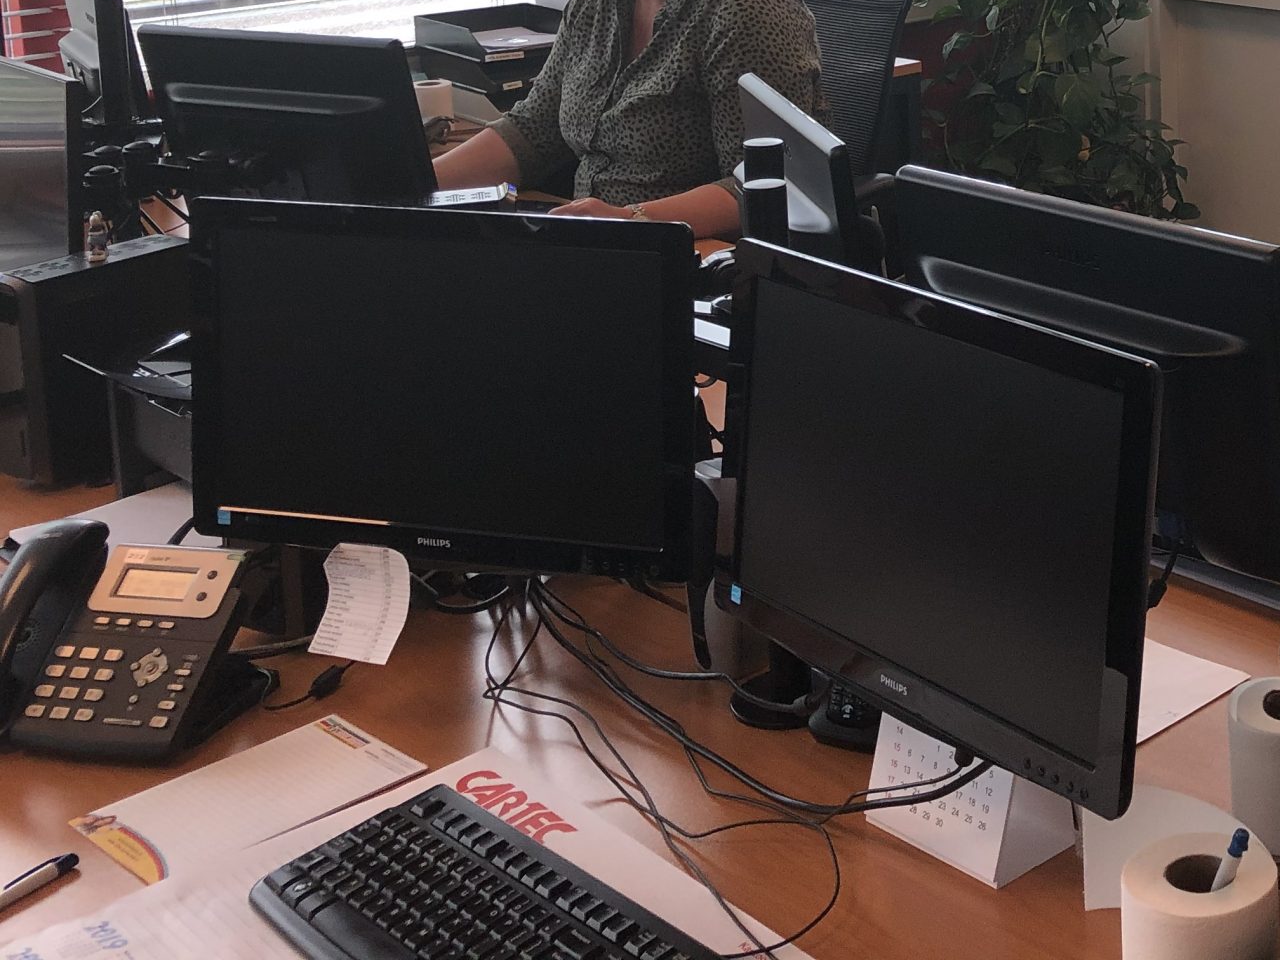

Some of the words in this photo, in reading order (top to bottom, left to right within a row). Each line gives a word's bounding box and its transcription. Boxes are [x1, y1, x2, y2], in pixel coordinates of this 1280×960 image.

[417, 537, 451, 548] PHILIPS
[880, 673, 908, 696] PHILIPS
[985, 787, 992, 796] 12
[456, 770, 578, 844] CARTEC
[968, 797, 976, 807] 18
[982, 804, 990, 814] 19
[922, 811, 931, 820] 29
[938, 801, 946, 810] 23
[951, 808, 960, 816] 24
[964, 814, 973, 823] 25
[978, 820, 986, 830] 26
